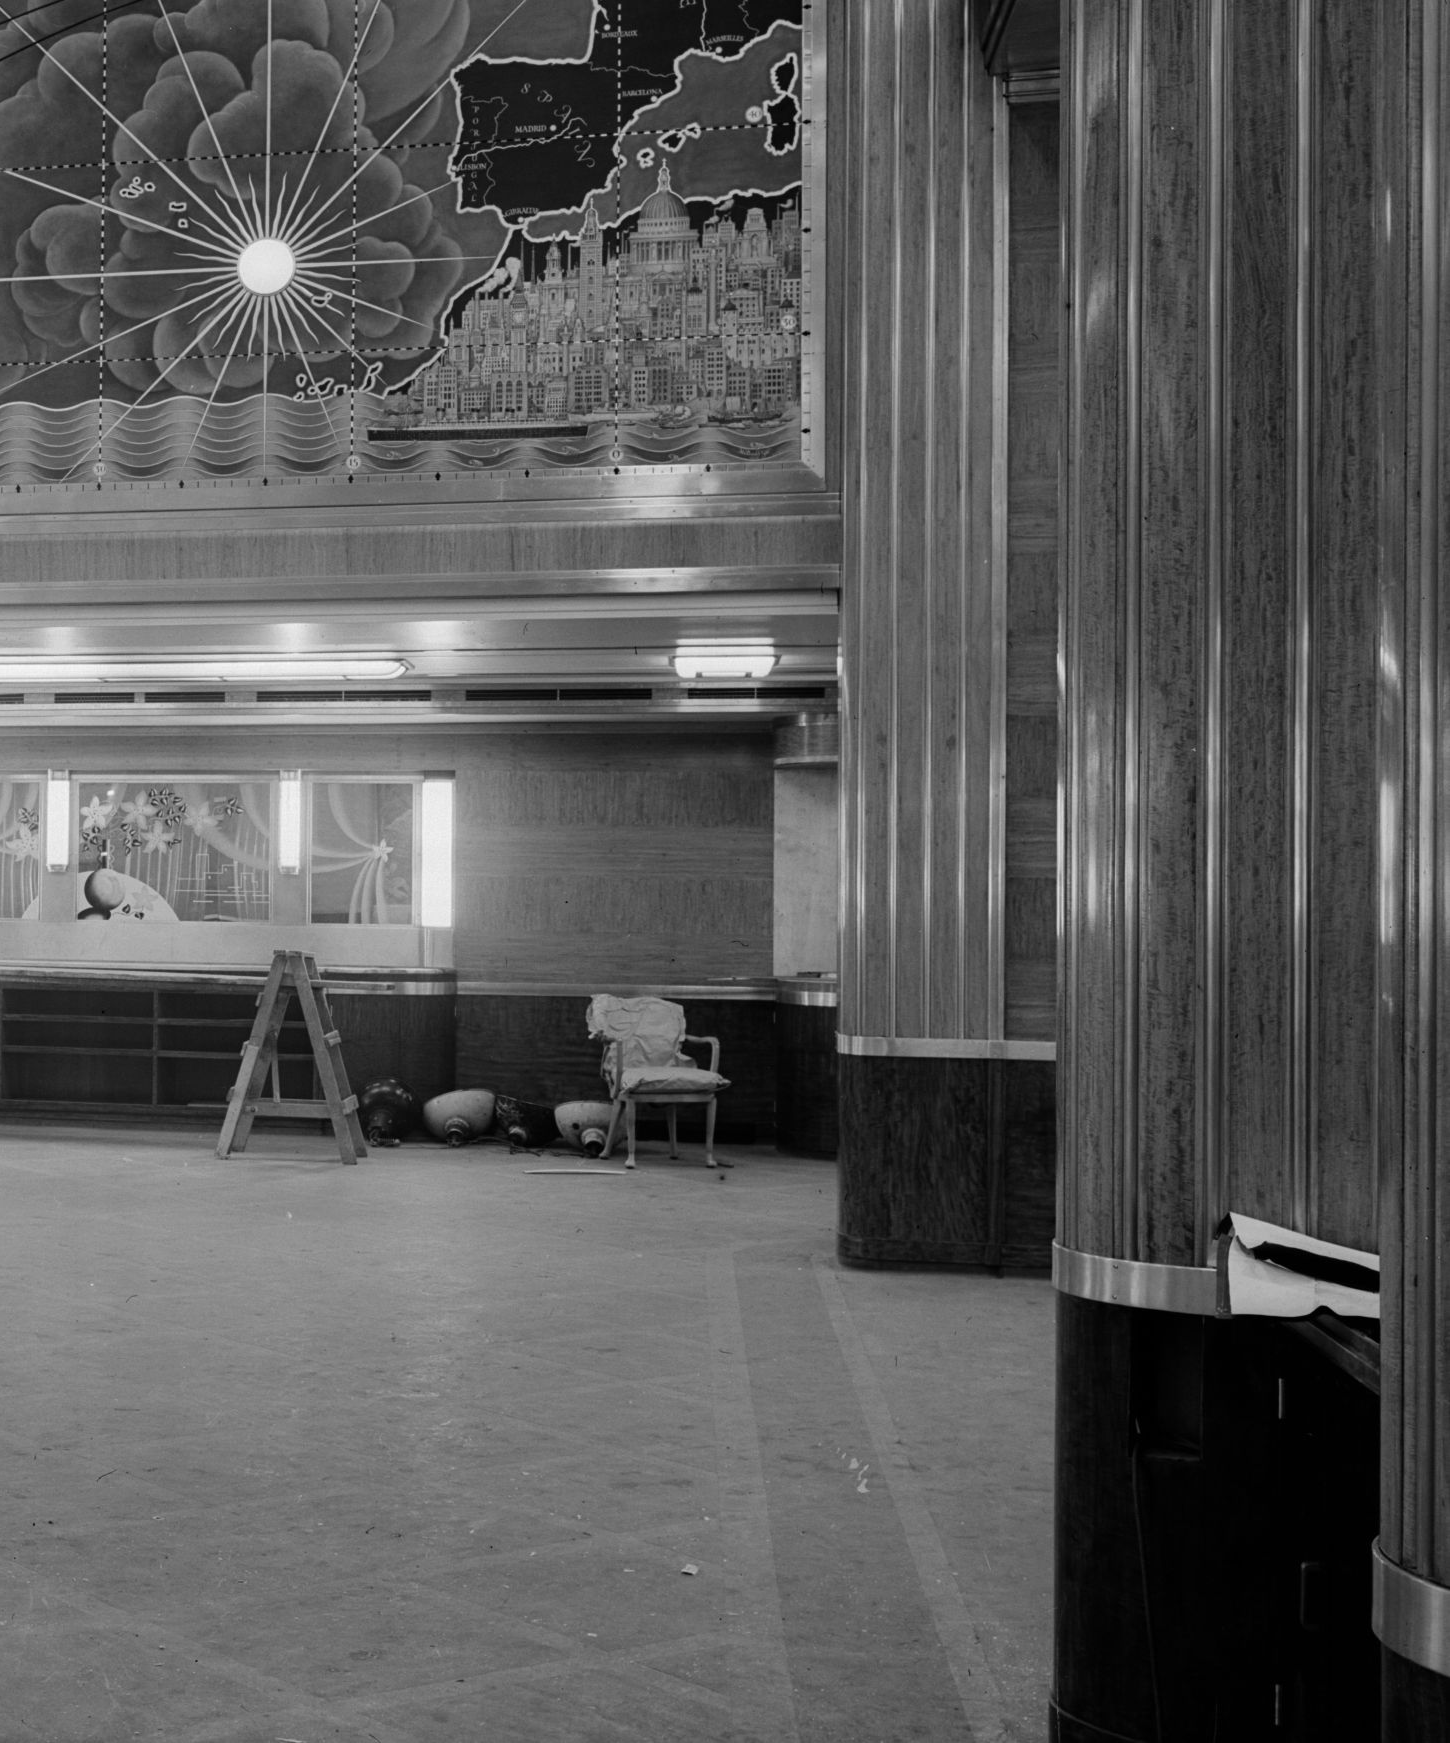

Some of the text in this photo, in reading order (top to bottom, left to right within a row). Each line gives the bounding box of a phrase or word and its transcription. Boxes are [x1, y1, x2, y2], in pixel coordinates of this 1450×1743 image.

[601, 29, 638, 39] BORDEAUX
[621, 88, 664, 98] BARCELONA
[514, 124, 547, 134] MADRID
[521, 83, 596, 168] SPAIN
[468, 105, 481, 202] PORTUGAL
[458, 162, 487, 172] LISBON
